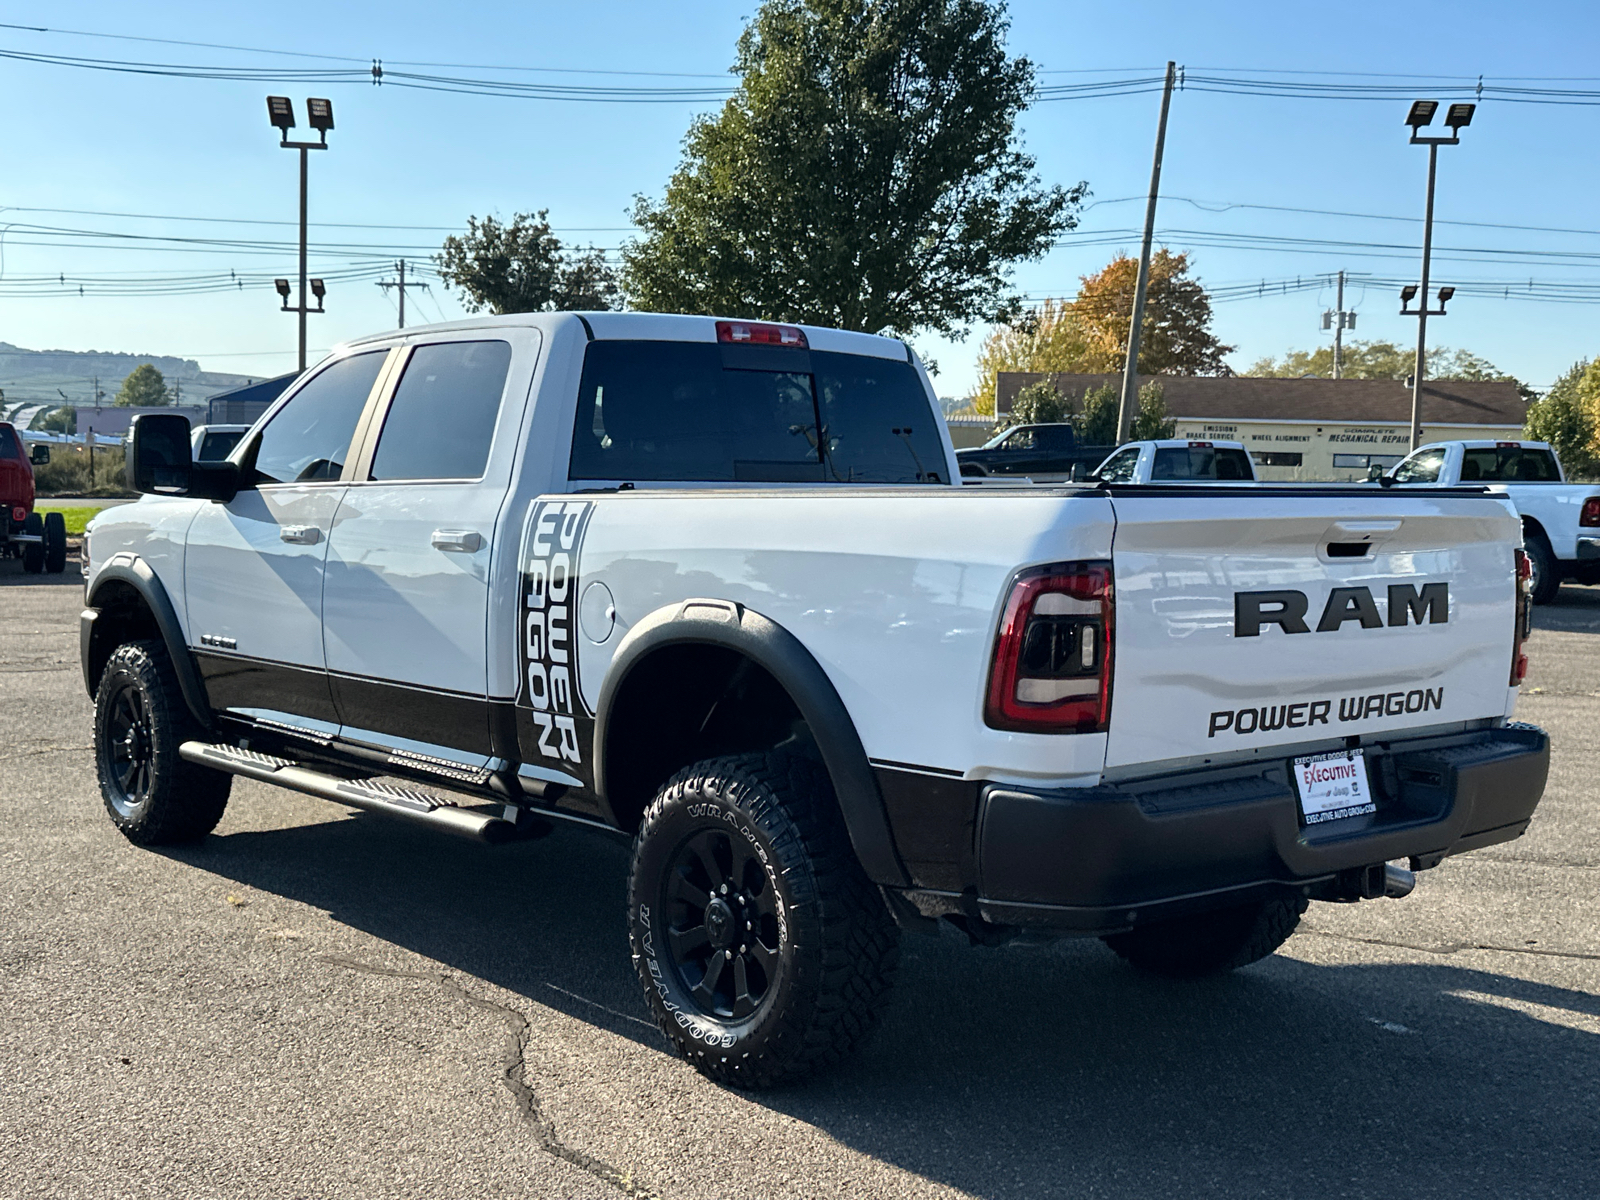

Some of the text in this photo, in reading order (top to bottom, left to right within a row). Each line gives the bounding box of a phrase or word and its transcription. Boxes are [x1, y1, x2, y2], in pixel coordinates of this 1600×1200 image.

[1328, 434, 1410, 443] MECHANICAL REPAIR
[526, 502, 561, 759] WAGON
[548, 502, 588, 764] POWER
[1234, 582, 1449, 638] RAM
[1208, 687, 1444, 738] POWER WAGON
[1304, 764, 1356, 792] EXECUTIVE
[1328, 752, 1348, 760] DODGE
[639, 903, 738, 1048] GOODYEAR
